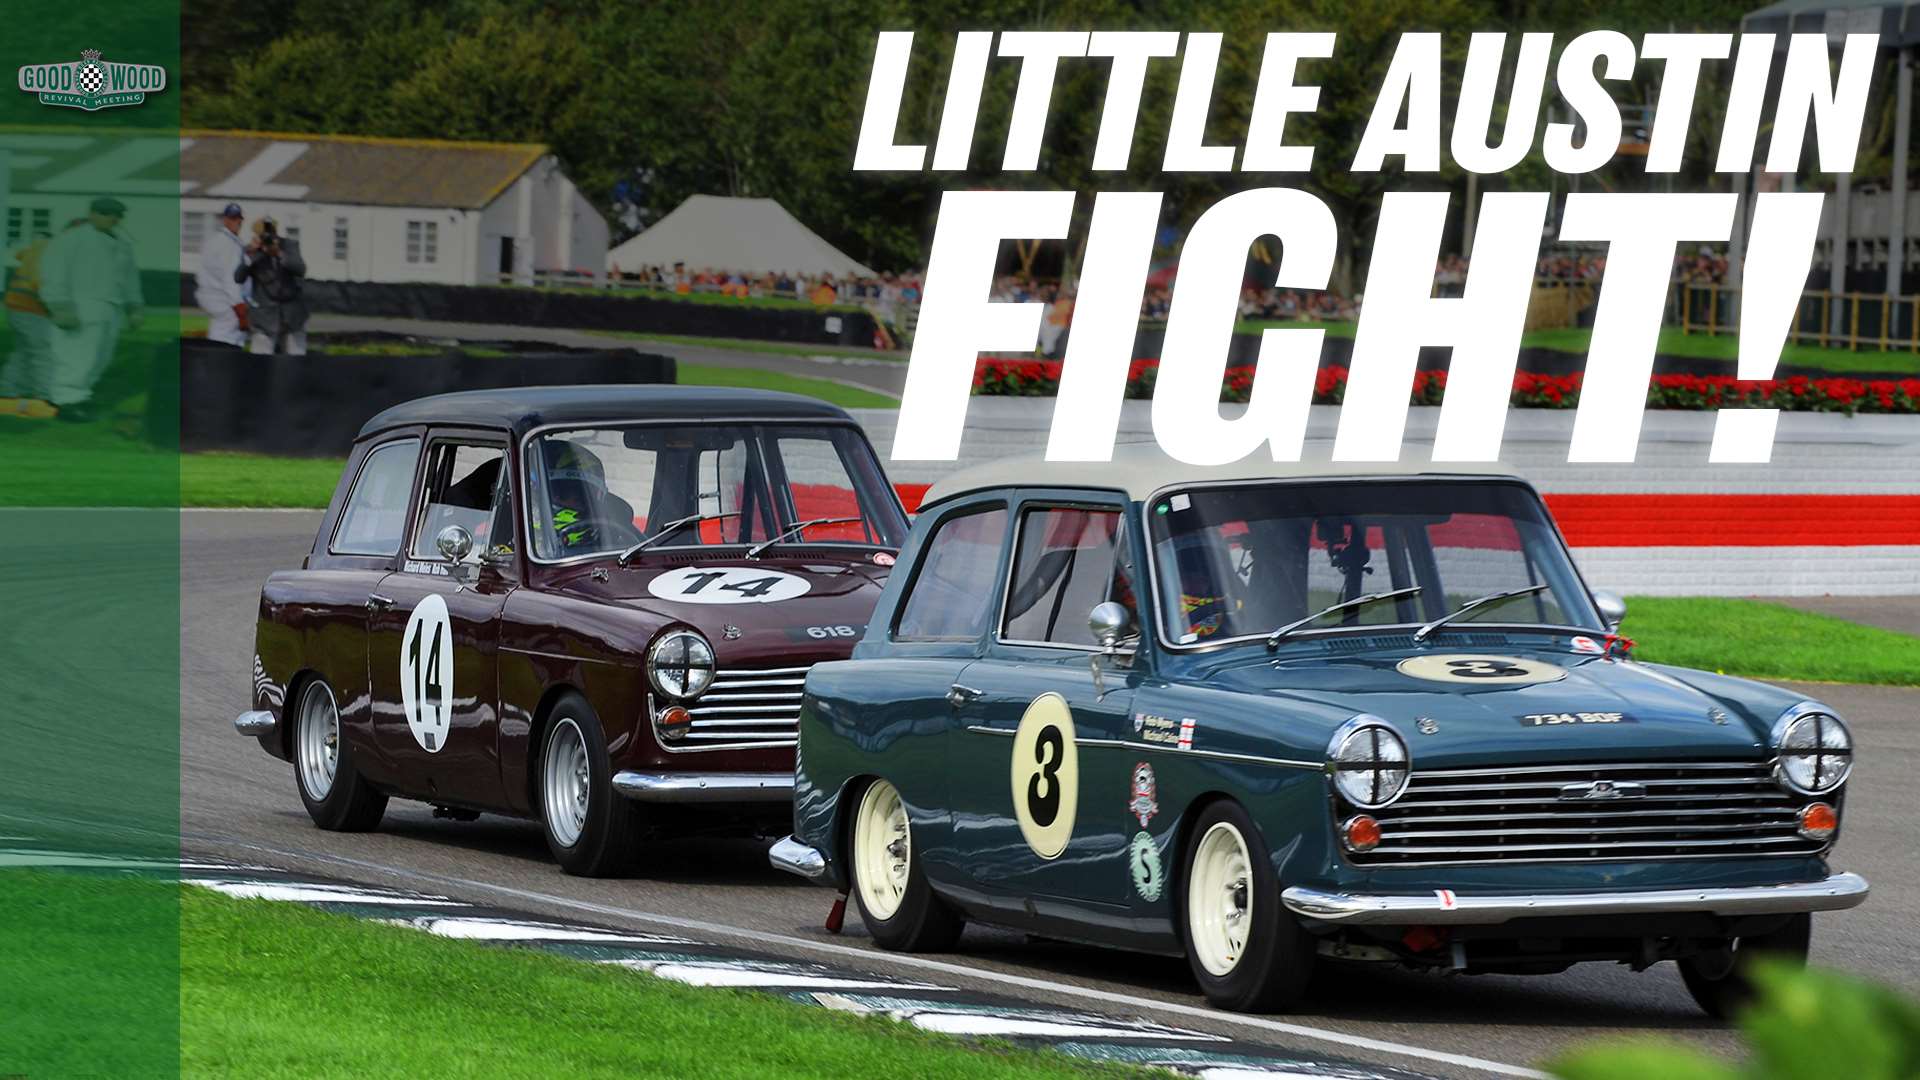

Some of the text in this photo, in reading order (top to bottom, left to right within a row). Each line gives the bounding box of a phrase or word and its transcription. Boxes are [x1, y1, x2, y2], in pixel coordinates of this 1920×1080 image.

[681, 572, 785, 597] 14
[806, 625, 856, 639] 618
[410, 618, 443, 726] 14
[1446, 659, 1529, 678] 3
[1525, 712, 1577, 725] 734
[1028, 724, 1064, 828] 3
